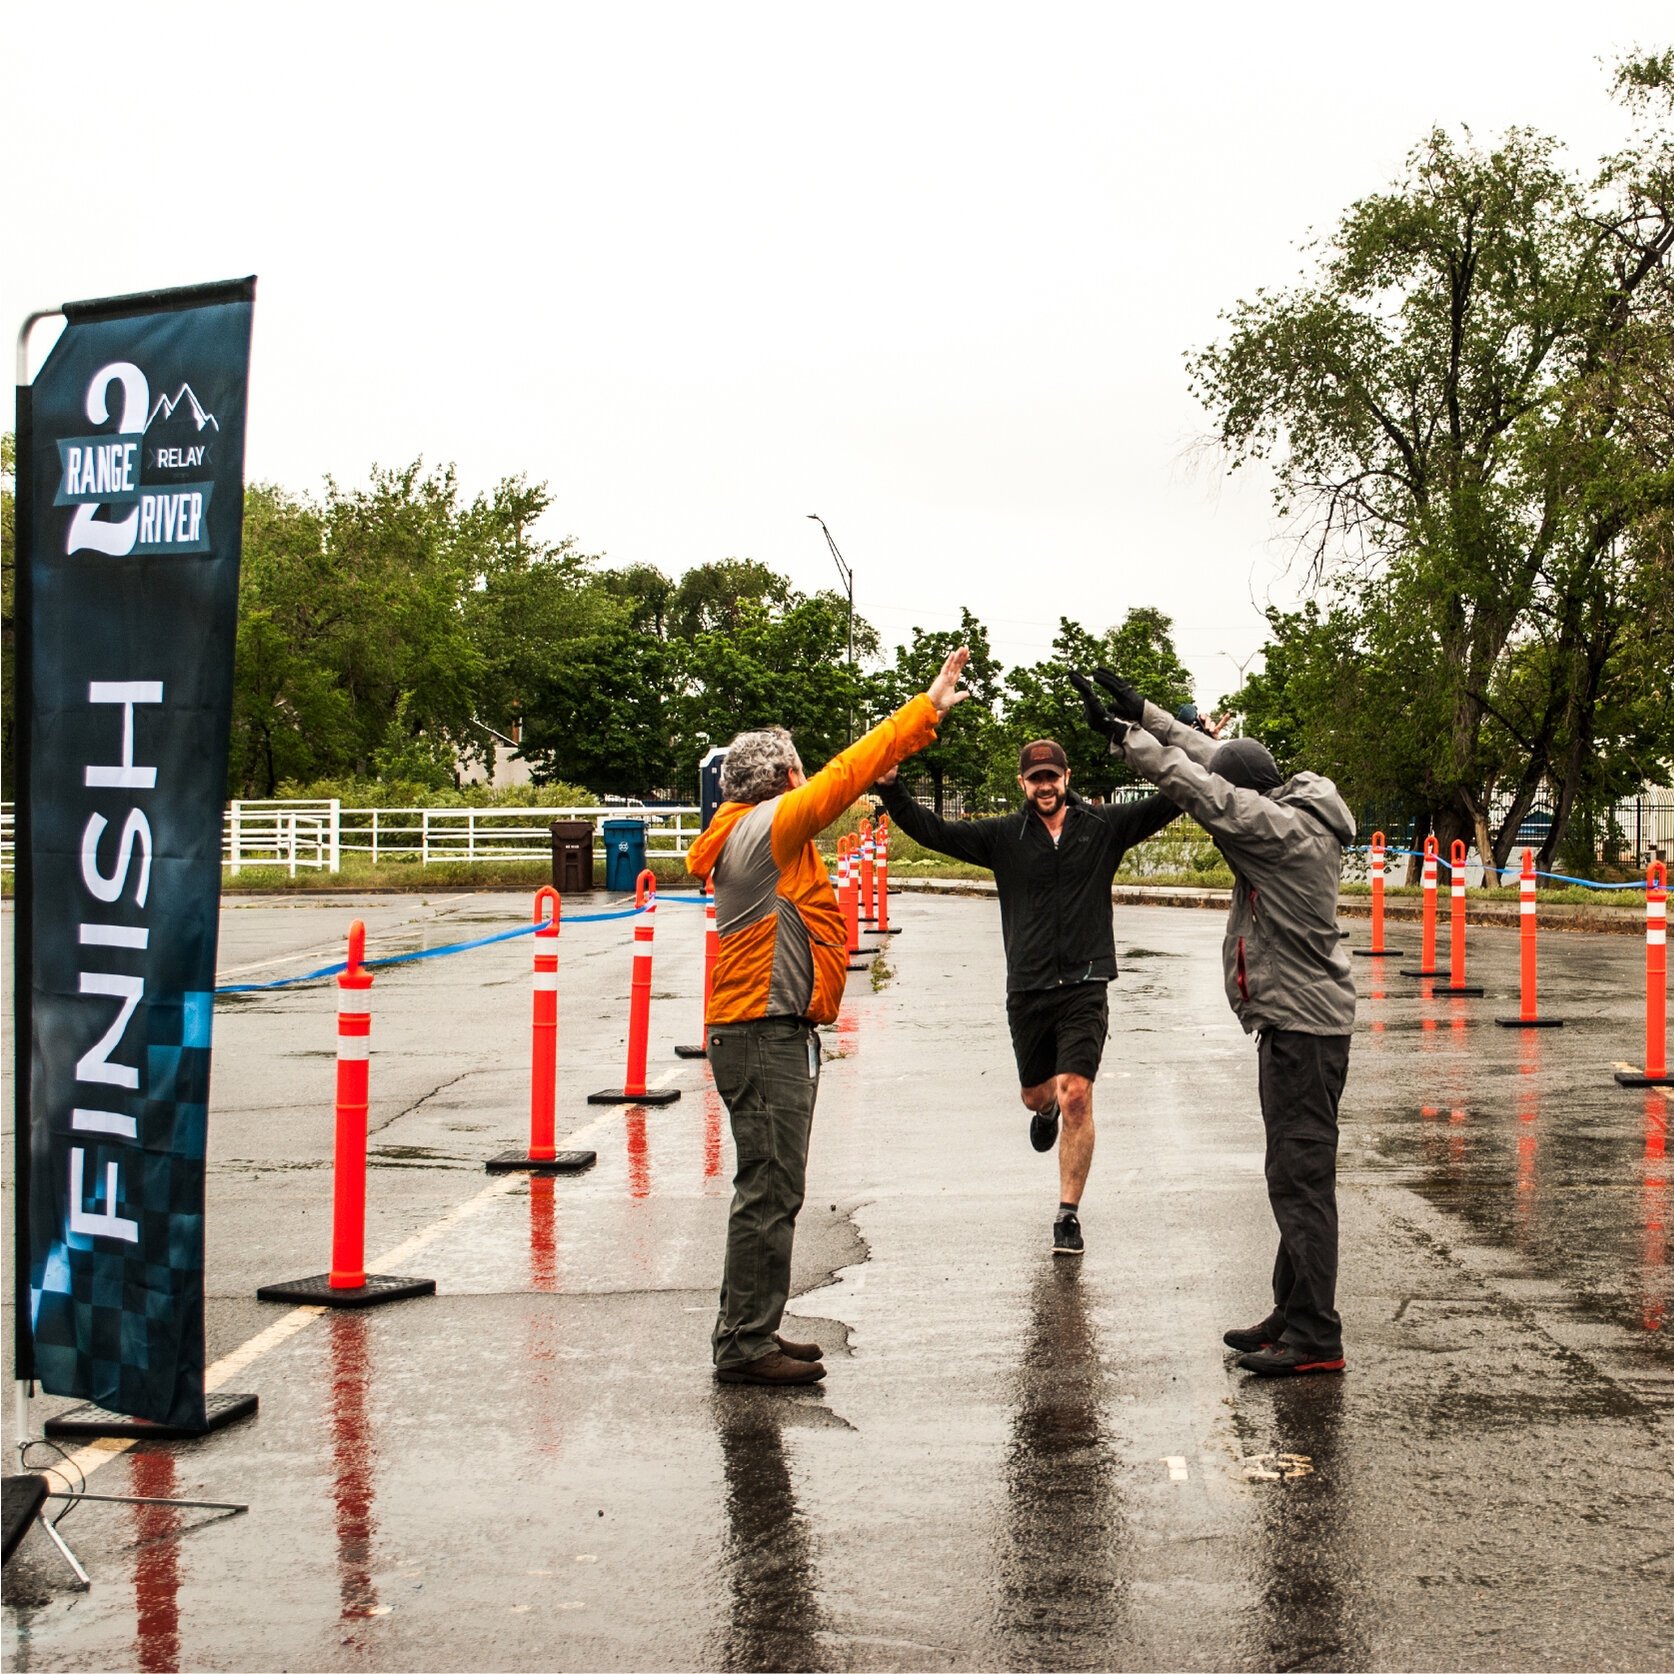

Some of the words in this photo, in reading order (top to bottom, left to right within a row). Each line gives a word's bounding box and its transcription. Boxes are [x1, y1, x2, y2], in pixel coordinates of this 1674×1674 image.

[66, 443, 137, 495] RANGE
[158, 446, 205, 468] RELAY
[140, 492, 202, 543] RIVER
[69, 681, 163, 1243] FINISH
